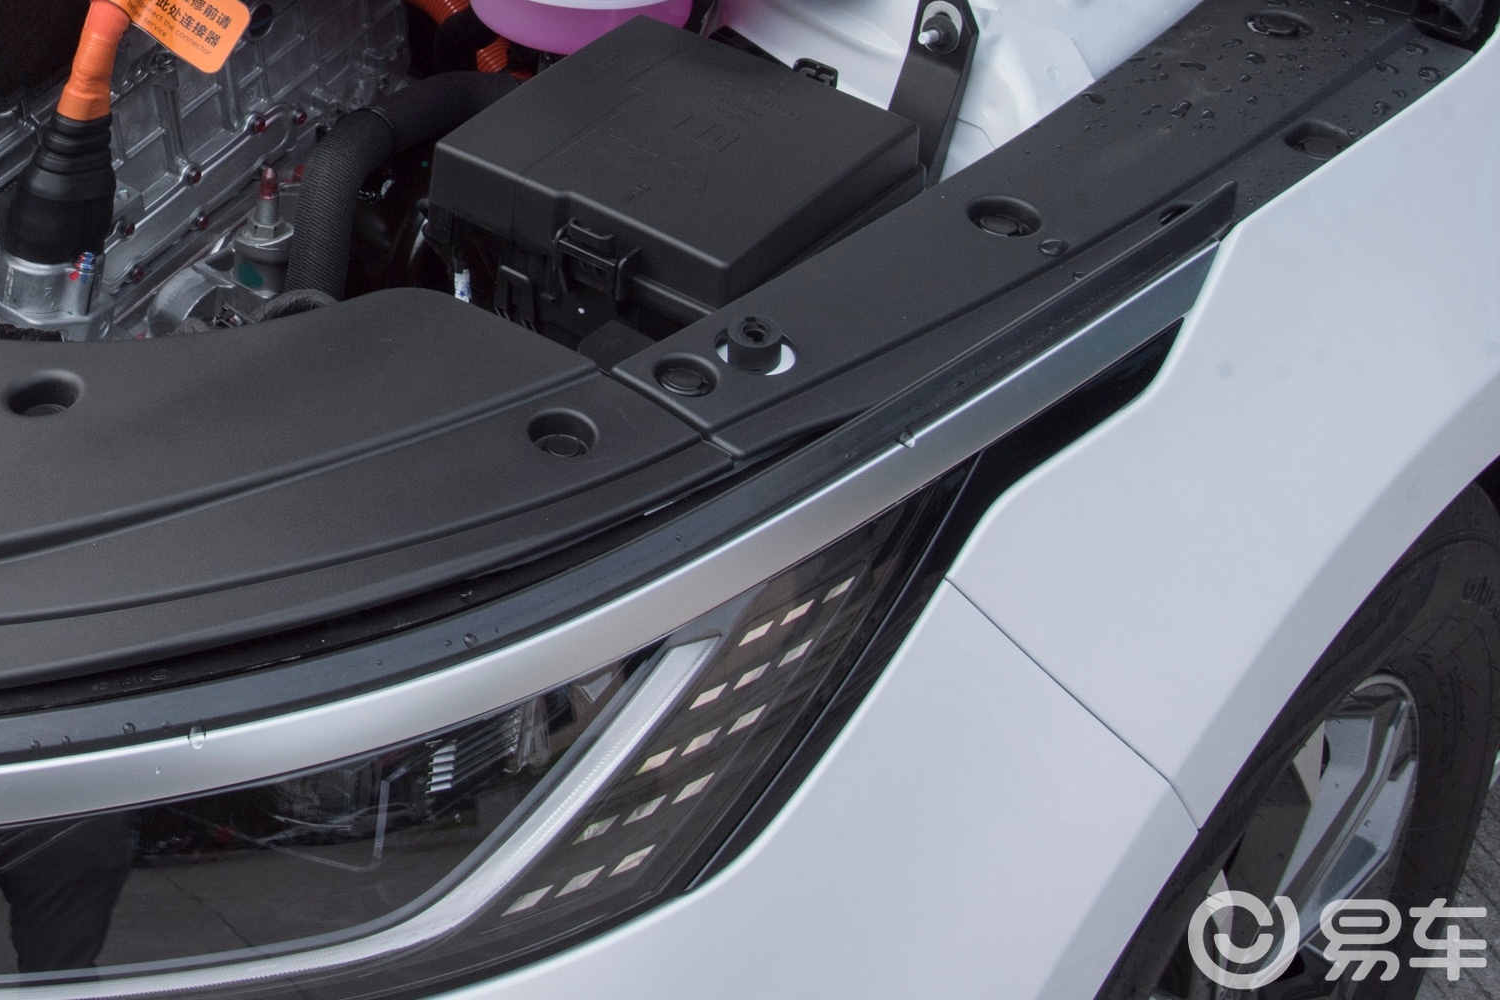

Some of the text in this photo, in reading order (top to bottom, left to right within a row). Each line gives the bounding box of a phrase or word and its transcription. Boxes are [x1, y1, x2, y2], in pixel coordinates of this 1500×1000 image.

[144, 17, 168, 38] service
[163, 18, 176, 32] the
[175, 28, 213, 57] connector
